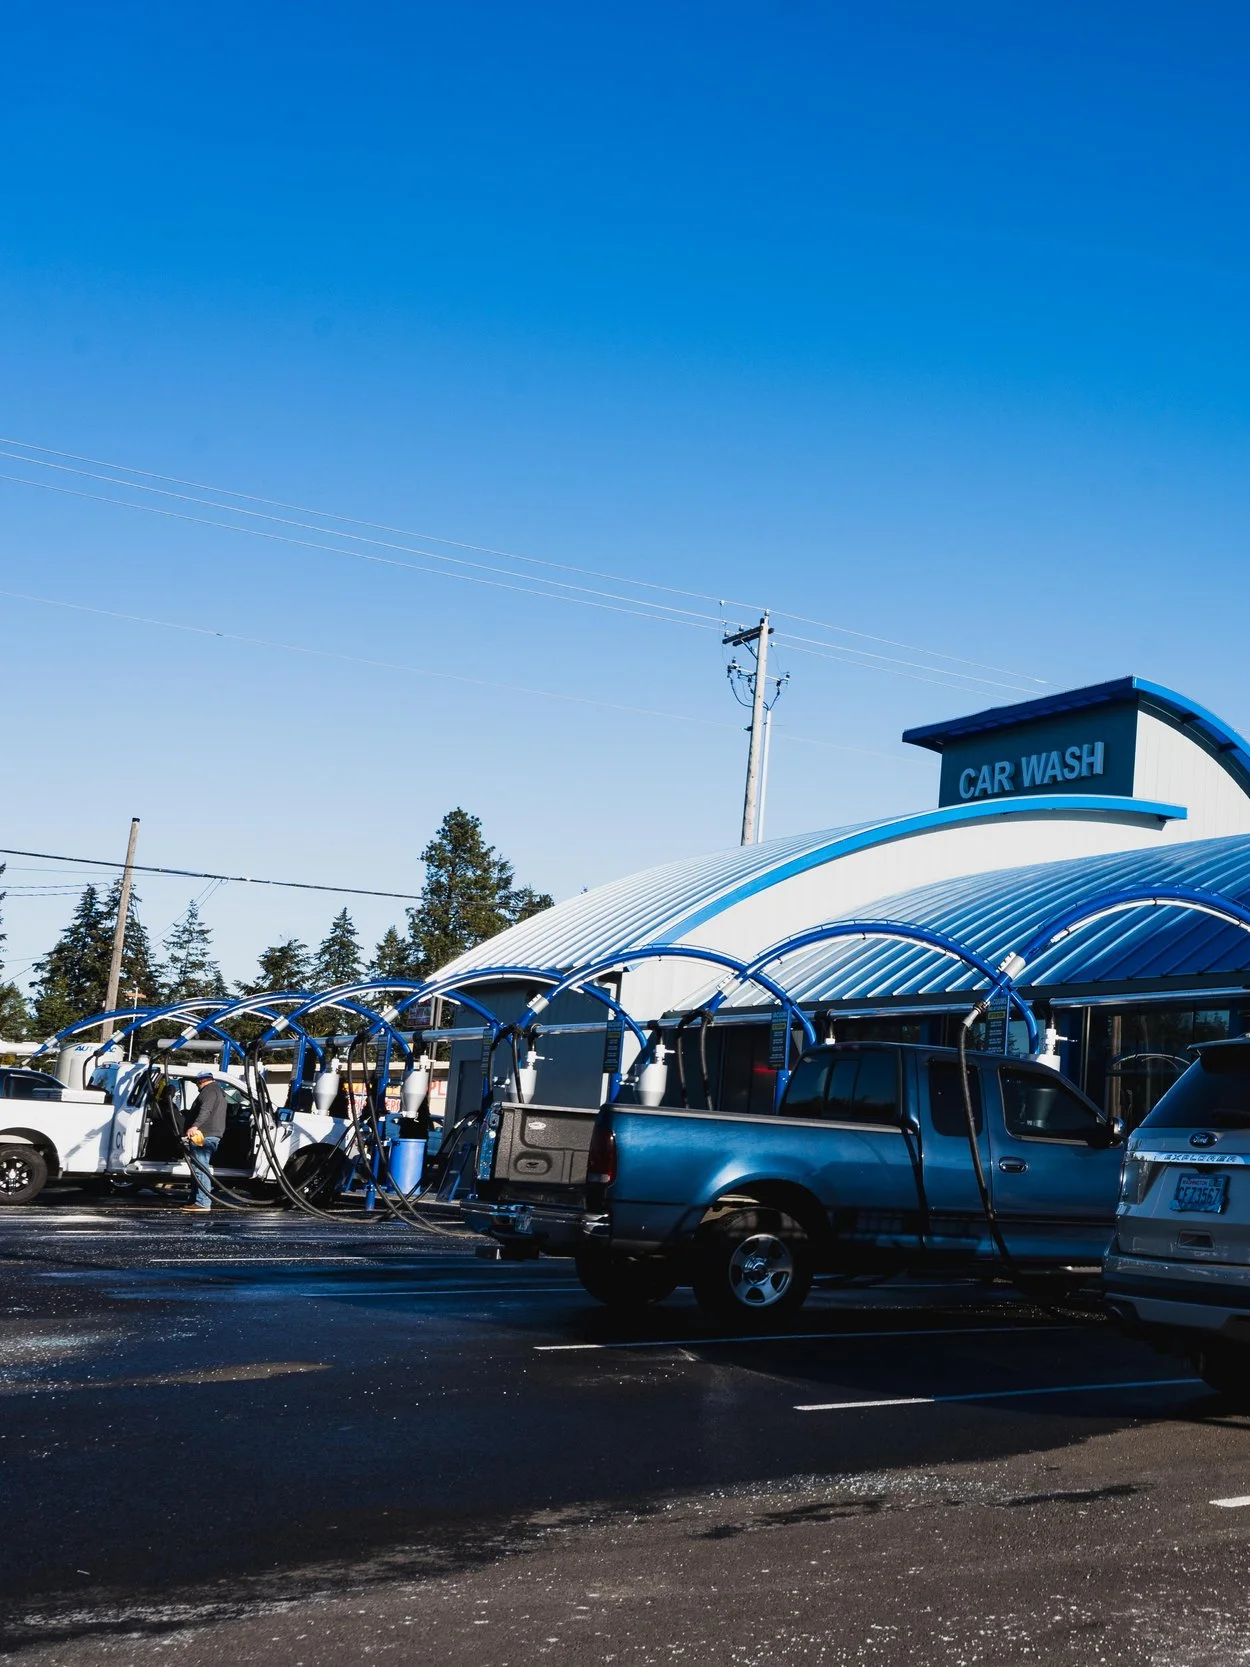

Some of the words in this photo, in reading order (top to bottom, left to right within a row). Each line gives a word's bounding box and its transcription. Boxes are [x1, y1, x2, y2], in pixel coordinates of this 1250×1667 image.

[959, 761, 1015, 799] CAR
[1021, 741, 1105, 788] WASH
[1193, 1133, 1209, 1144] Ford
[1164, 1154, 1237, 1162] EXPLORER
